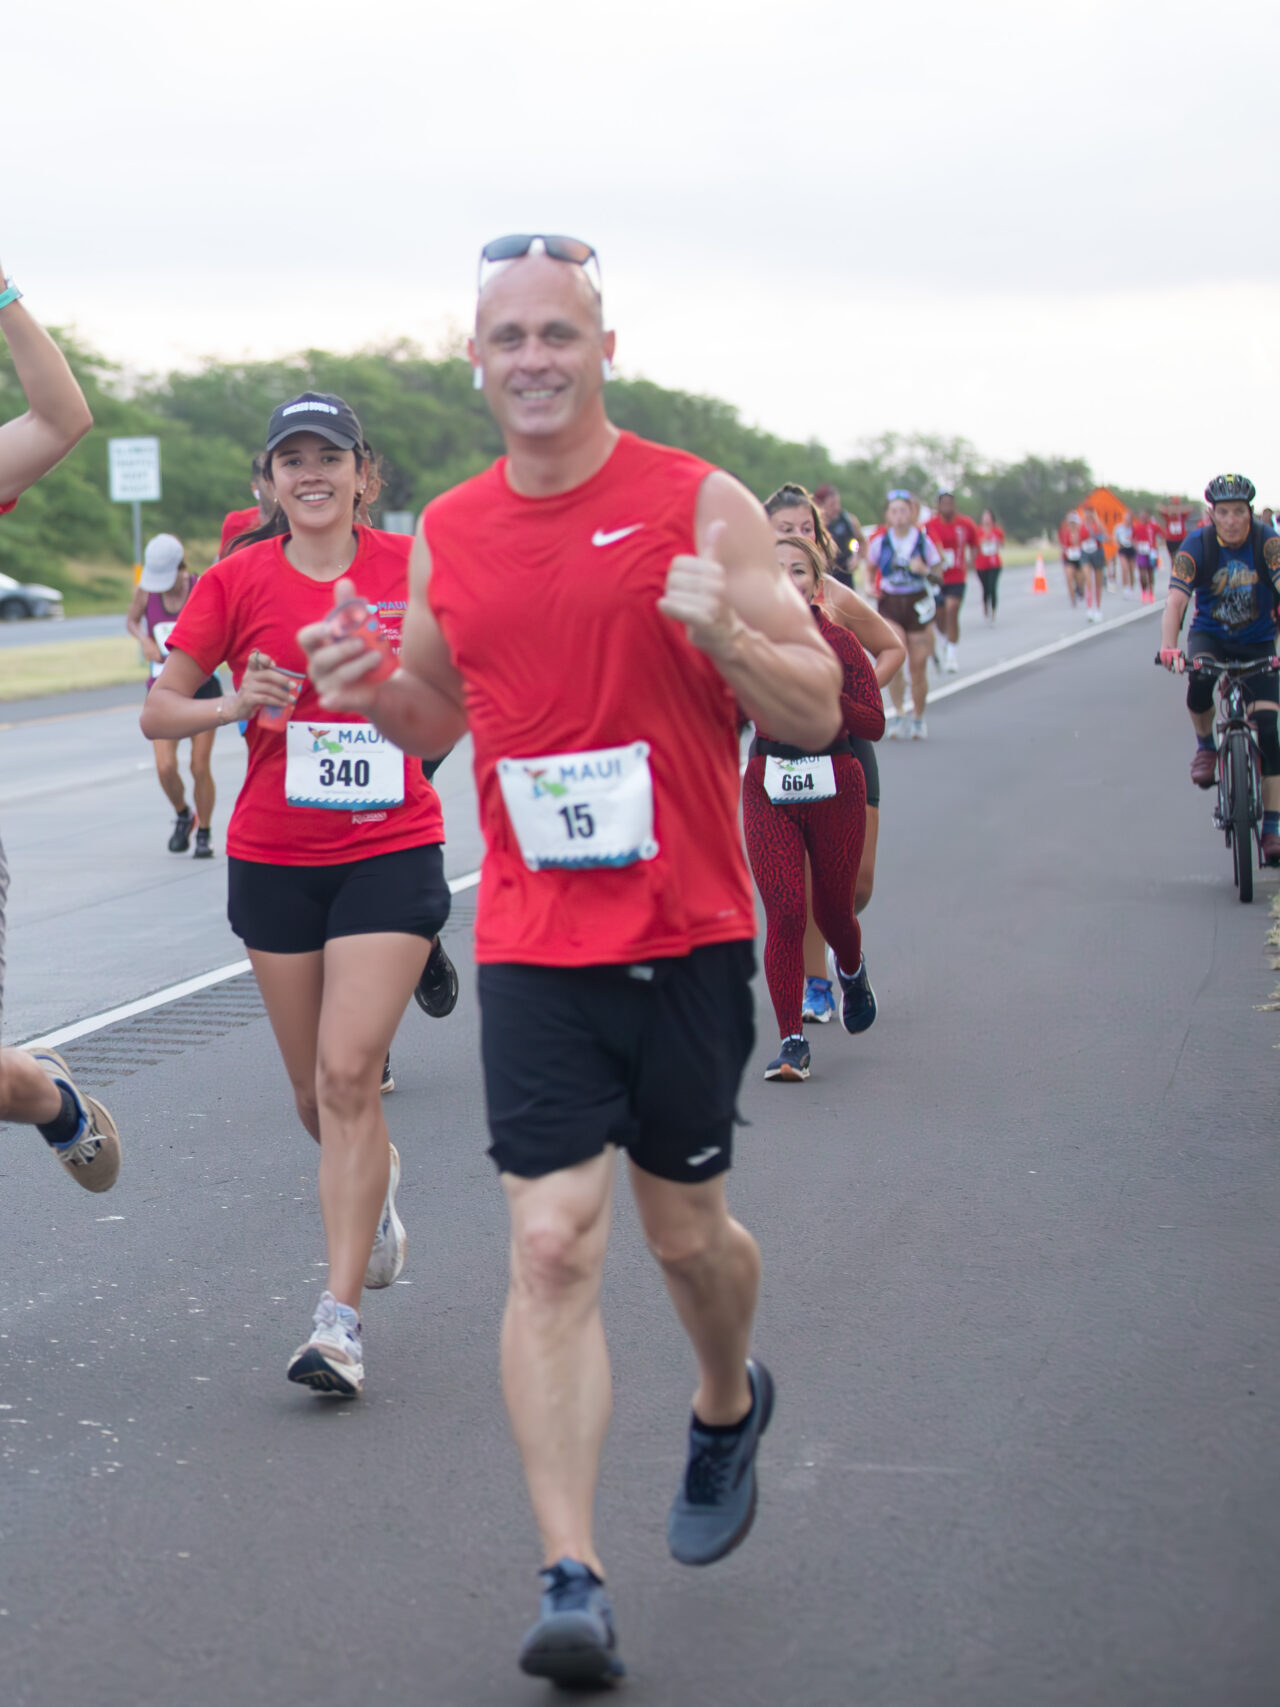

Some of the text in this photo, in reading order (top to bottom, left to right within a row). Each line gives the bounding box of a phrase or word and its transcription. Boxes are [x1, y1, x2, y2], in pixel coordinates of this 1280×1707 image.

[319, 758, 370, 787] 340
[560, 759, 622, 781] MAUI
[782, 772, 815, 791] 664
[558, 804, 595, 840] 15
